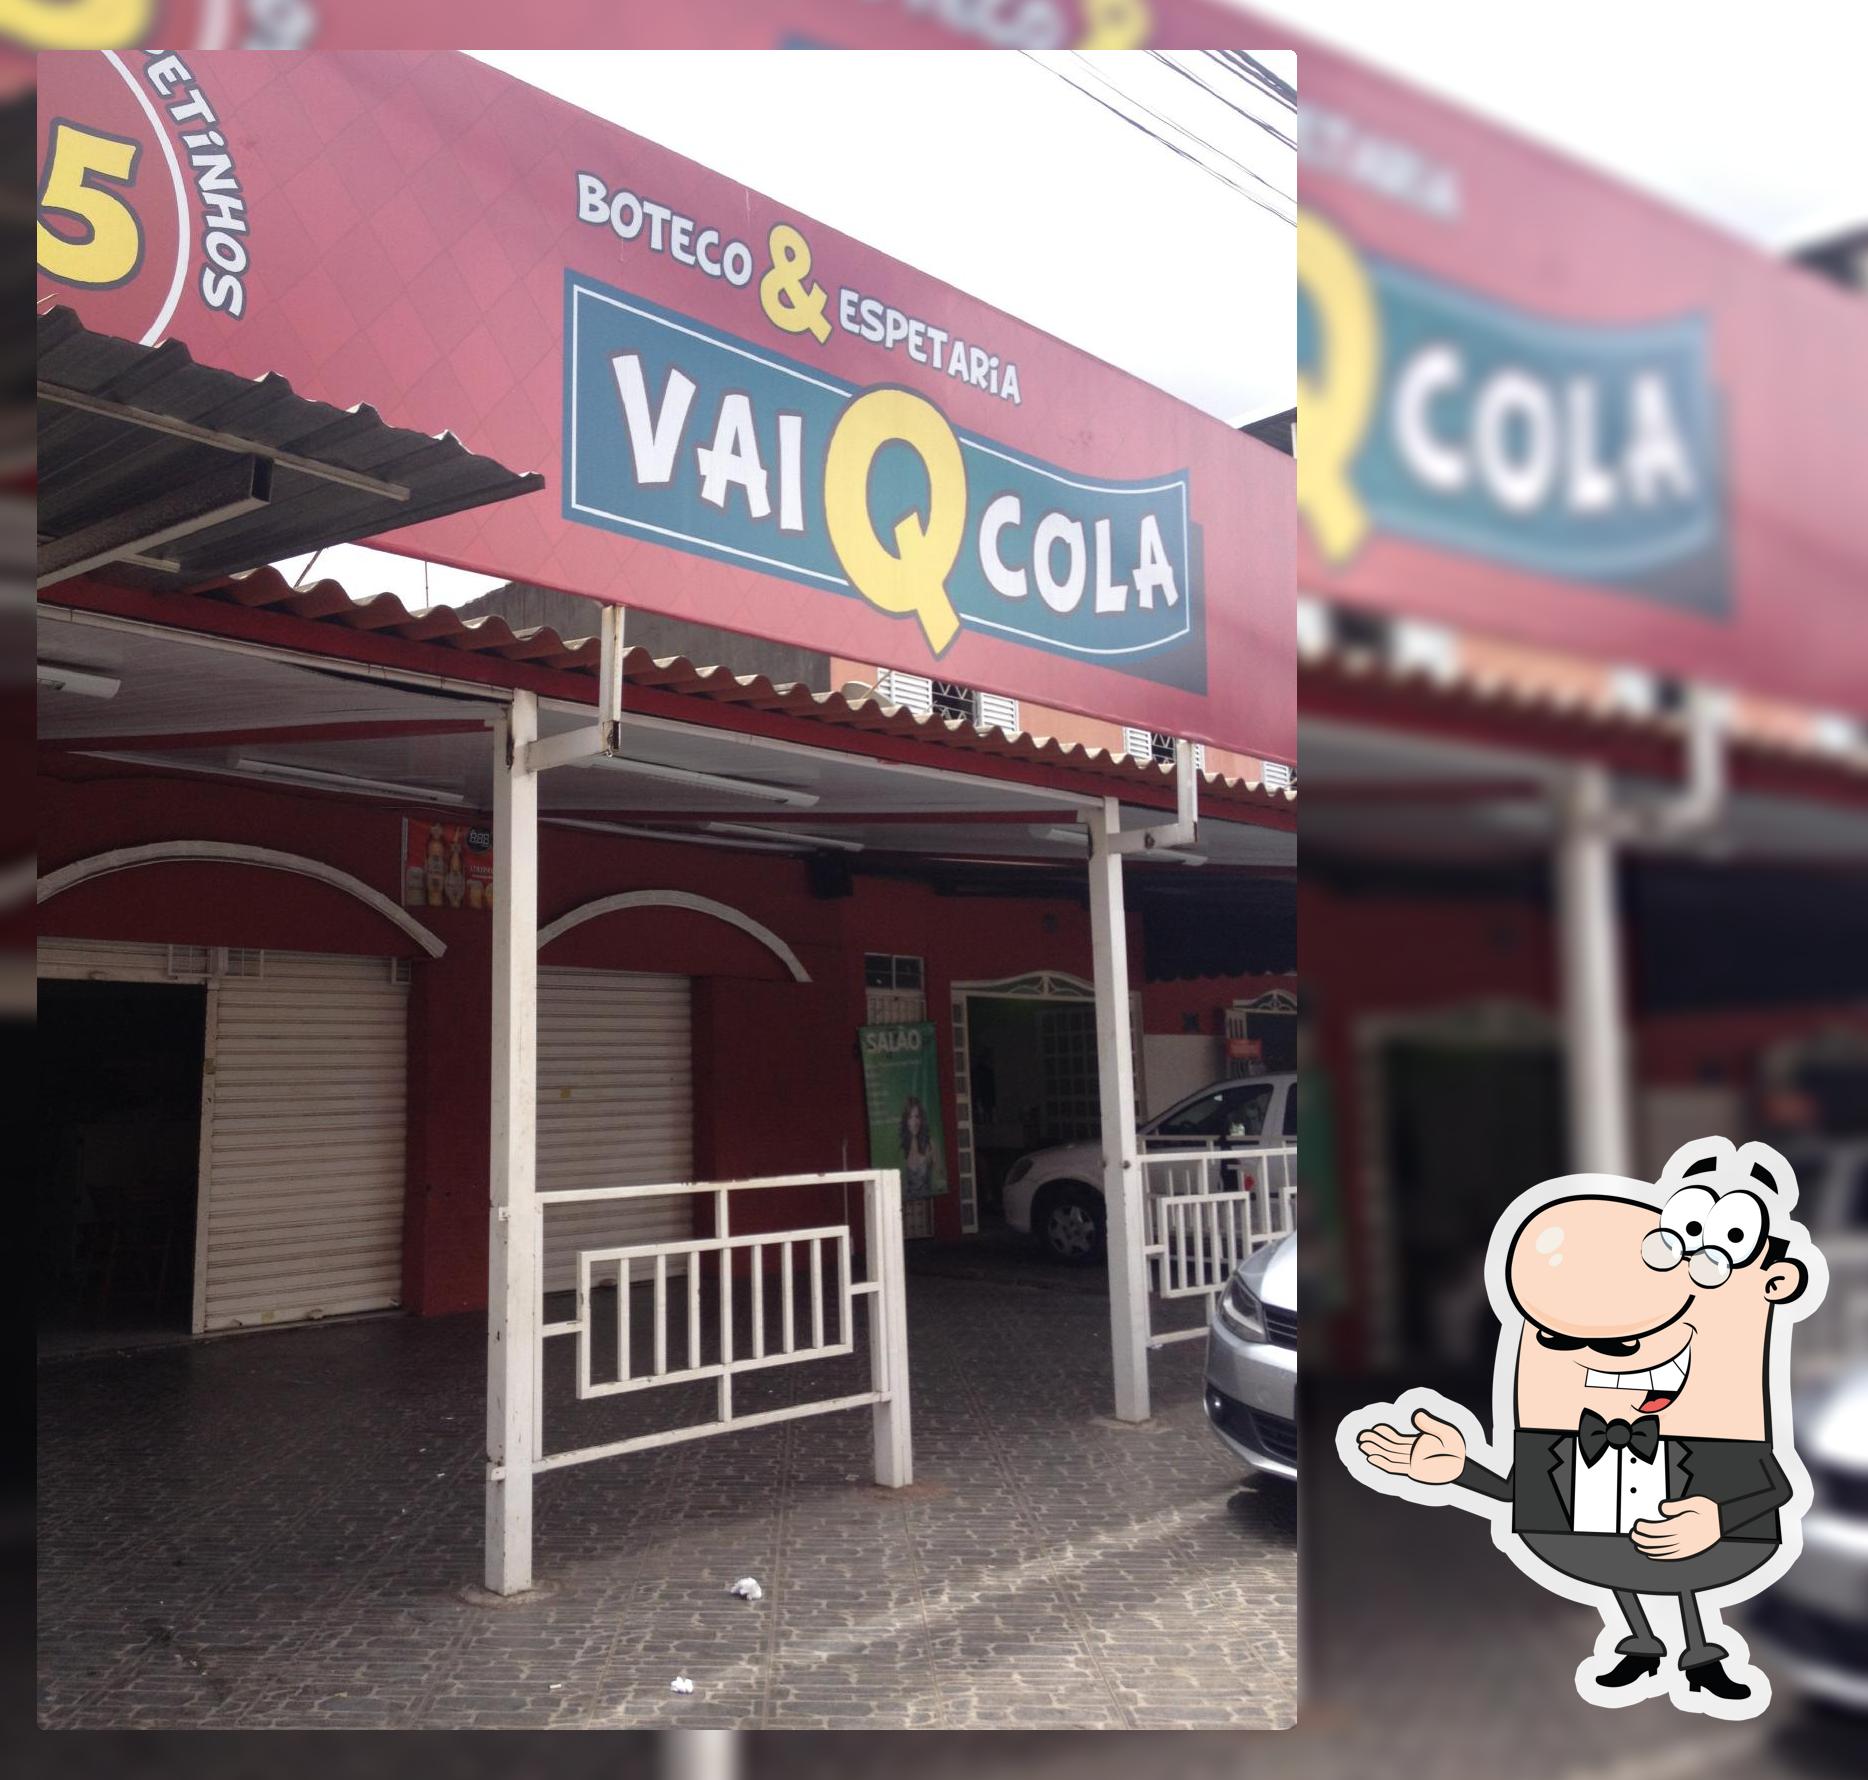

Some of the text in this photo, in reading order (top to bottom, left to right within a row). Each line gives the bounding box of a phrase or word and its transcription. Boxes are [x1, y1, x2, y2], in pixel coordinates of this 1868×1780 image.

[37, 123, 138, 285] 5
[144, 50, 248, 318] ETiNHOS
[576, 172, 753, 286] BOTECO
[759, 223, 833, 343] &
[611, 353, 1179, 656] VAI Q COLA
